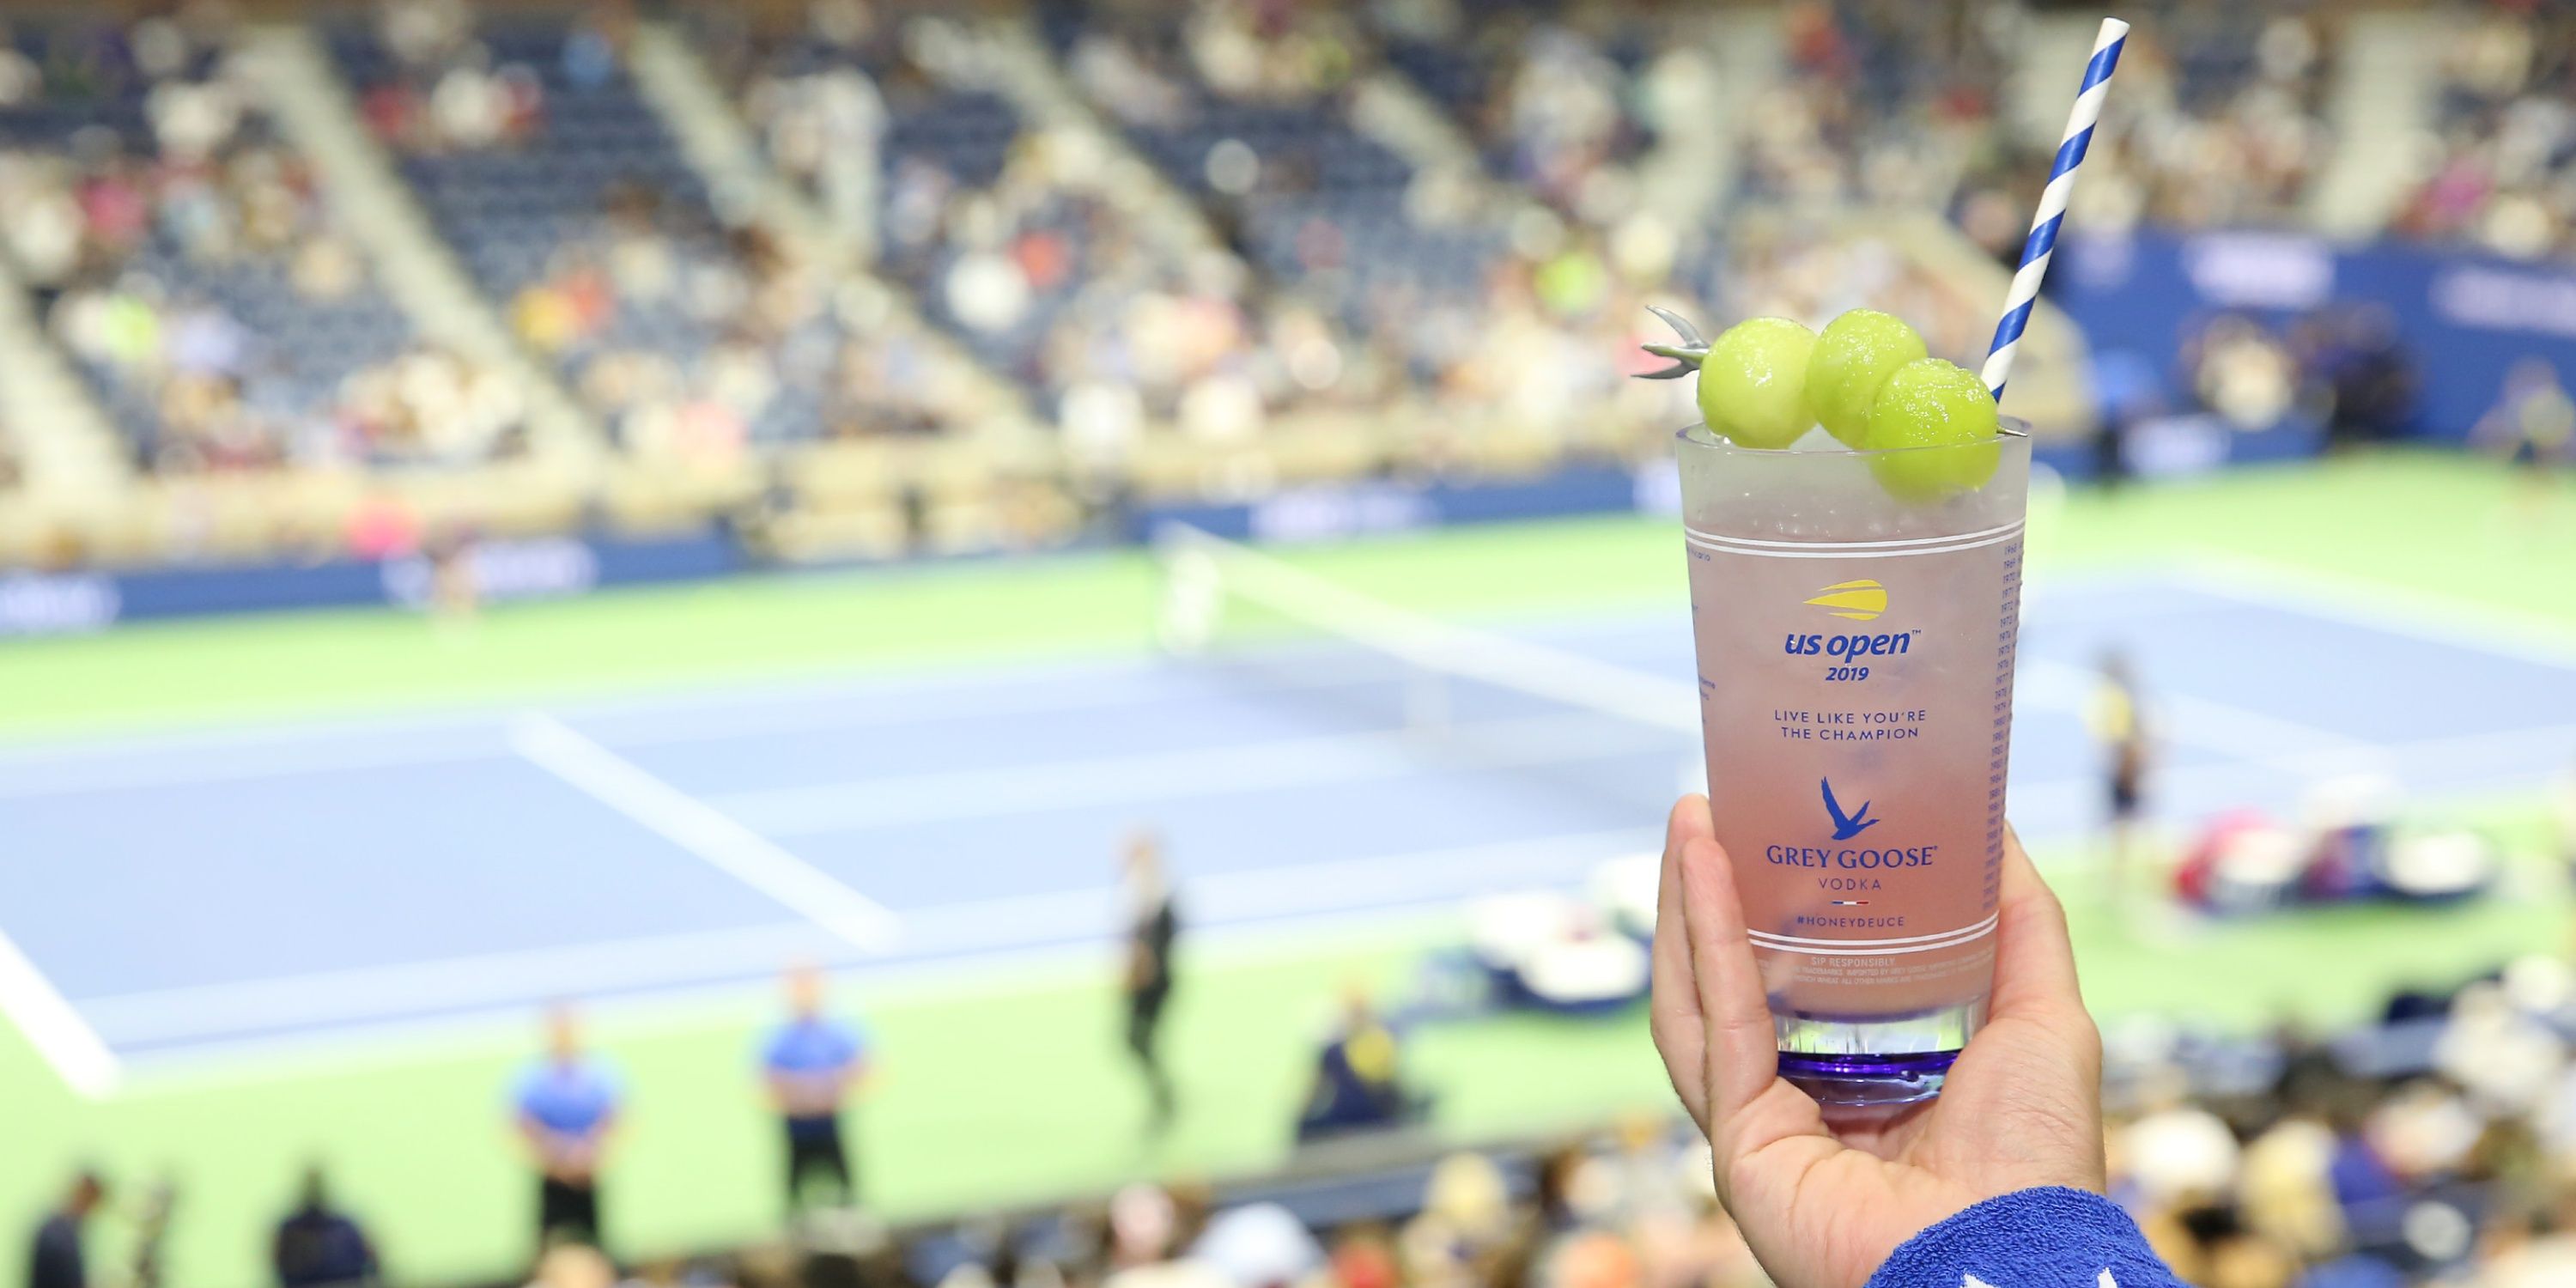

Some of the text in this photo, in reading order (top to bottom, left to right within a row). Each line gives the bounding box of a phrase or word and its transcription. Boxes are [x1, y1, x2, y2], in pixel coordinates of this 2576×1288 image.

[1784, 634, 1823, 655] us
[1826, 632, 1911, 664] open
[1826, 666, 1869, 681] 2019
[1775, 709, 1926, 724] LIVE LIKE YOU'RE
[1781, 726, 1919, 741] THE CHAMPION
[1766, 845, 1934, 869] GREY GOOSE
[1818, 878, 1882, 890] VODKA
[1797, 915, 1905, 928] #HONEYDEUCE
[1811, 957, 1896, 968] SIP RESPONSIBLY
